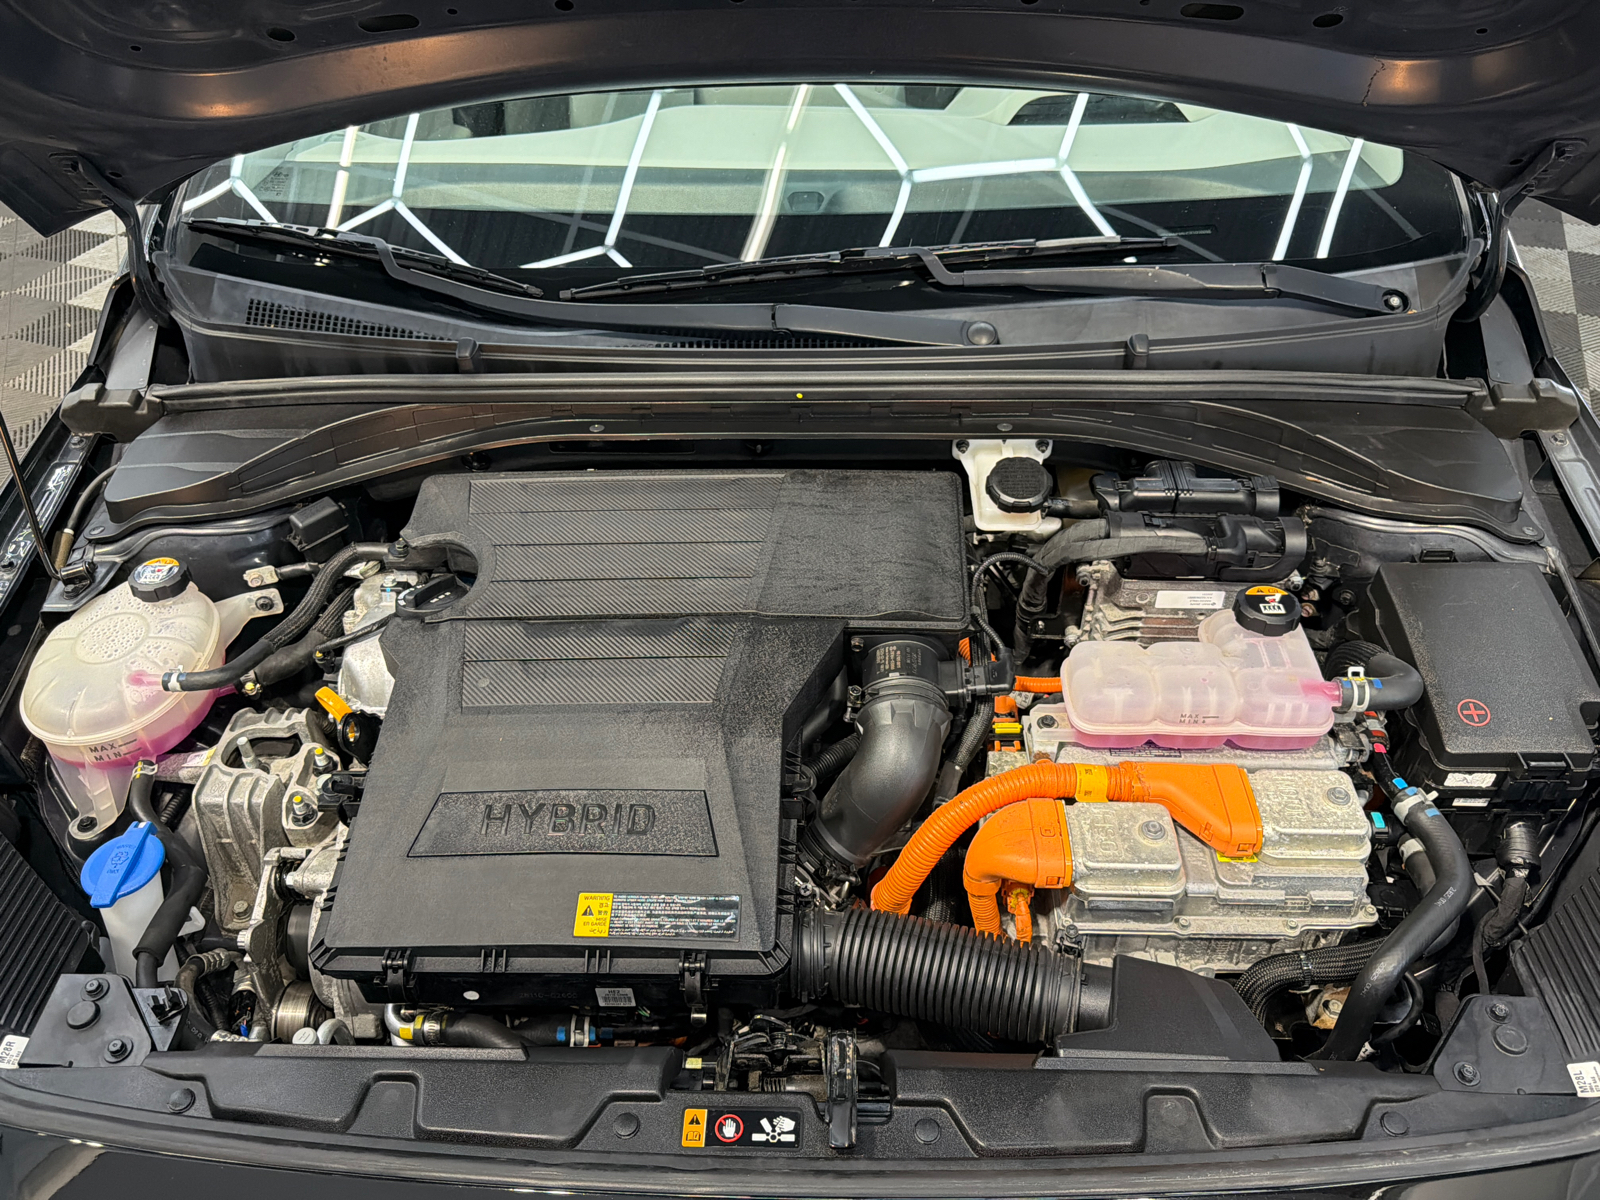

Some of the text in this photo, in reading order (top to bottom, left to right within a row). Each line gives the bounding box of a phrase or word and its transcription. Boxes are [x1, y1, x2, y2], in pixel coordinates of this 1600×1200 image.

[88, 743, 117, 753] MAX
[94, 751, 122, 762] MIN
[480, 803, 656, 836] HYBRID
[0, 1041, 16, 1064] M28R
[1573, 1070, 1590, 1094] M28L
